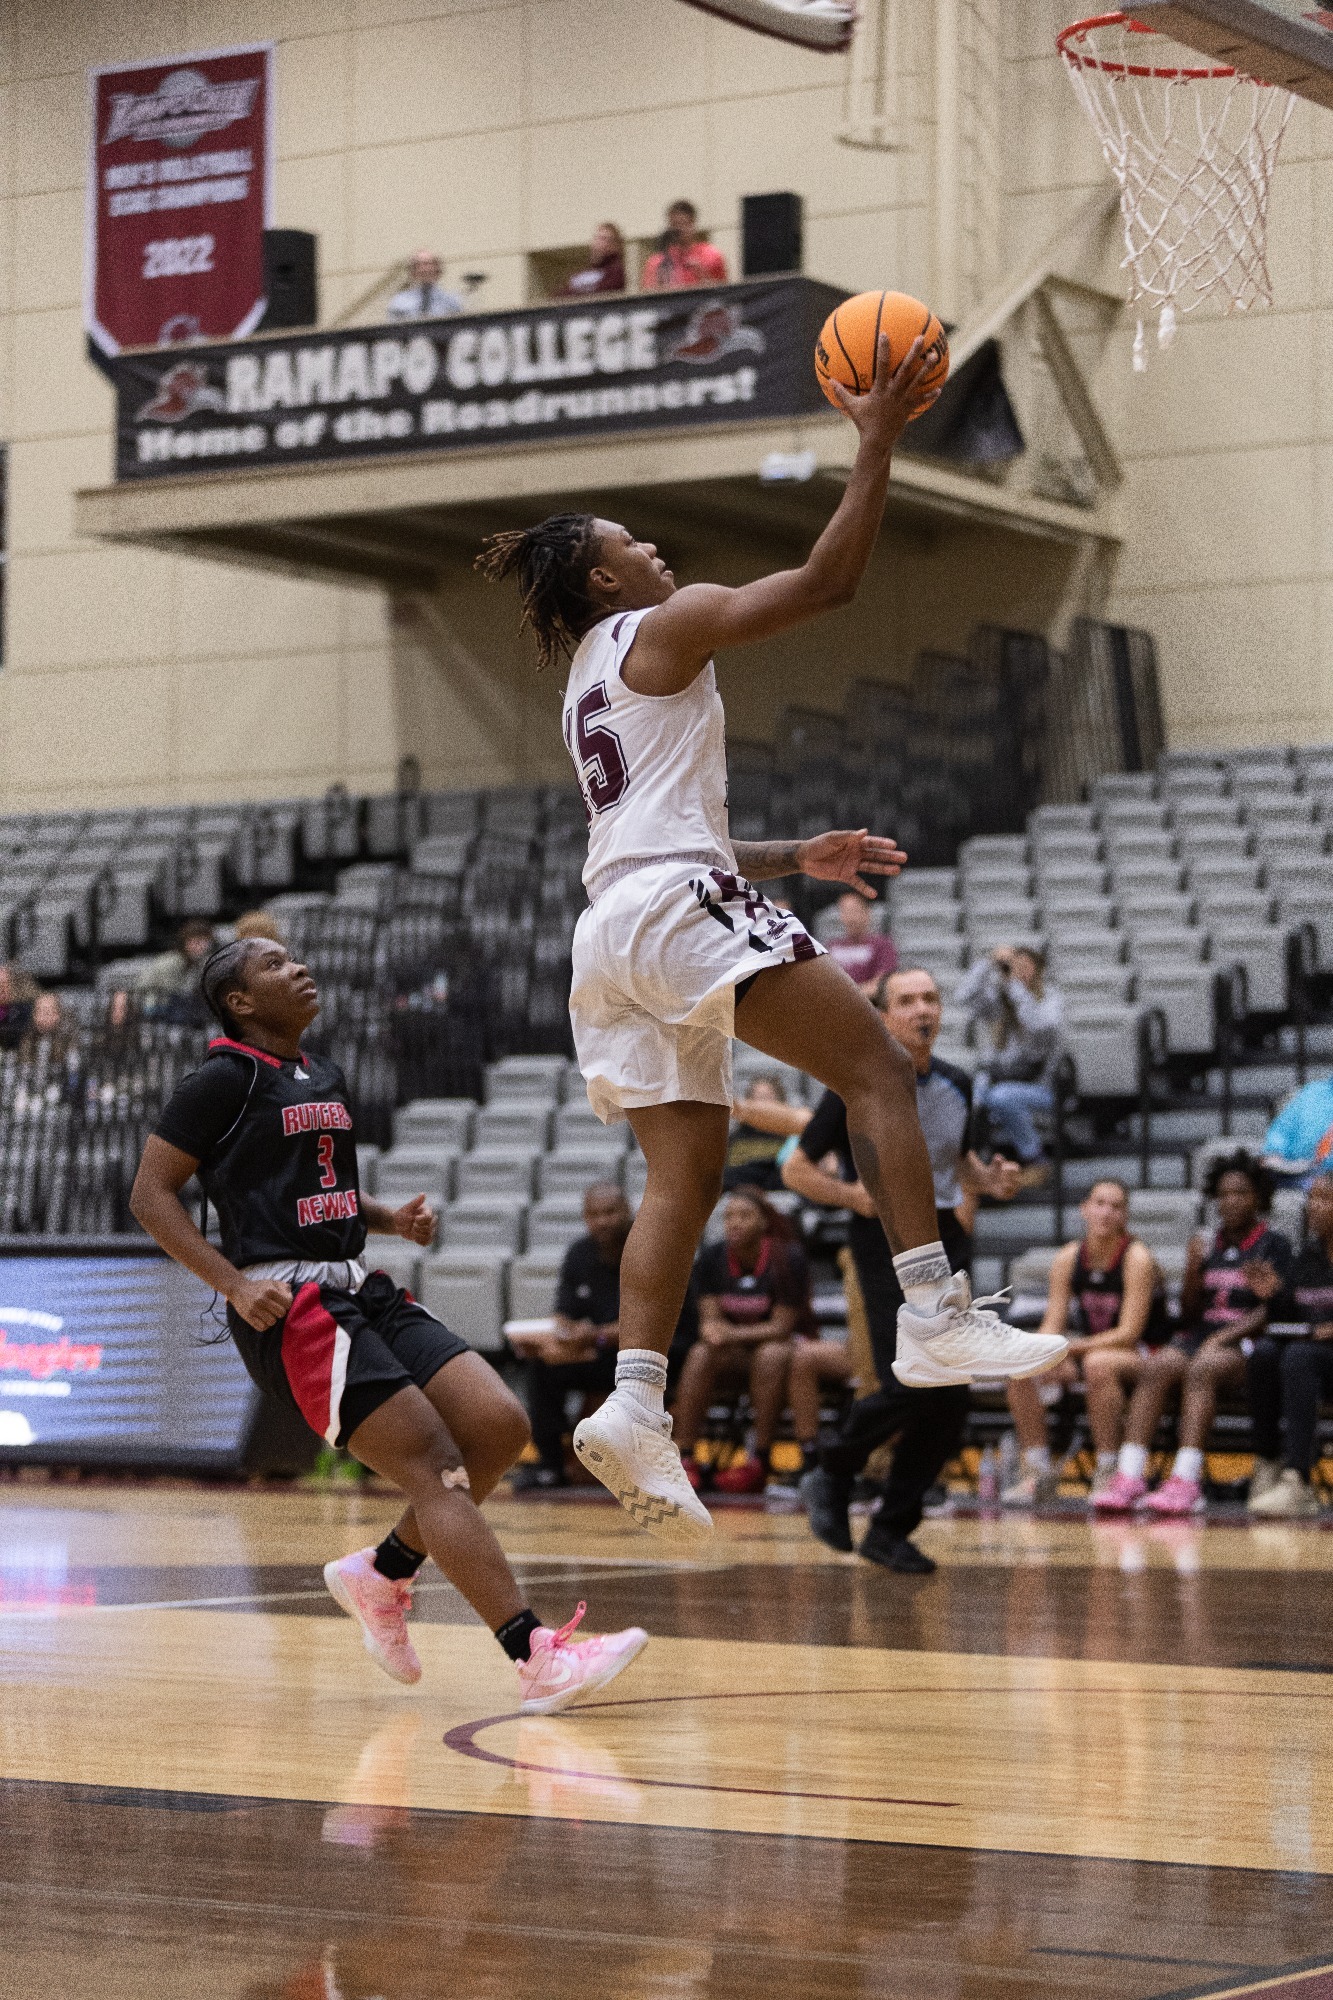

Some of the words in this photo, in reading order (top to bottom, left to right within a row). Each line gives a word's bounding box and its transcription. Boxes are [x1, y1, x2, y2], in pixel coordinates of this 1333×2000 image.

[224, 333, 437, 413] RAMAPO
[447, 311, 658, 388] COLLEGE
[138, 423, 266, 462] Home
[273, 410, 325, 447] of
[333, 402, 412, 440] the
[318, 1135, 336, 1188] 3
